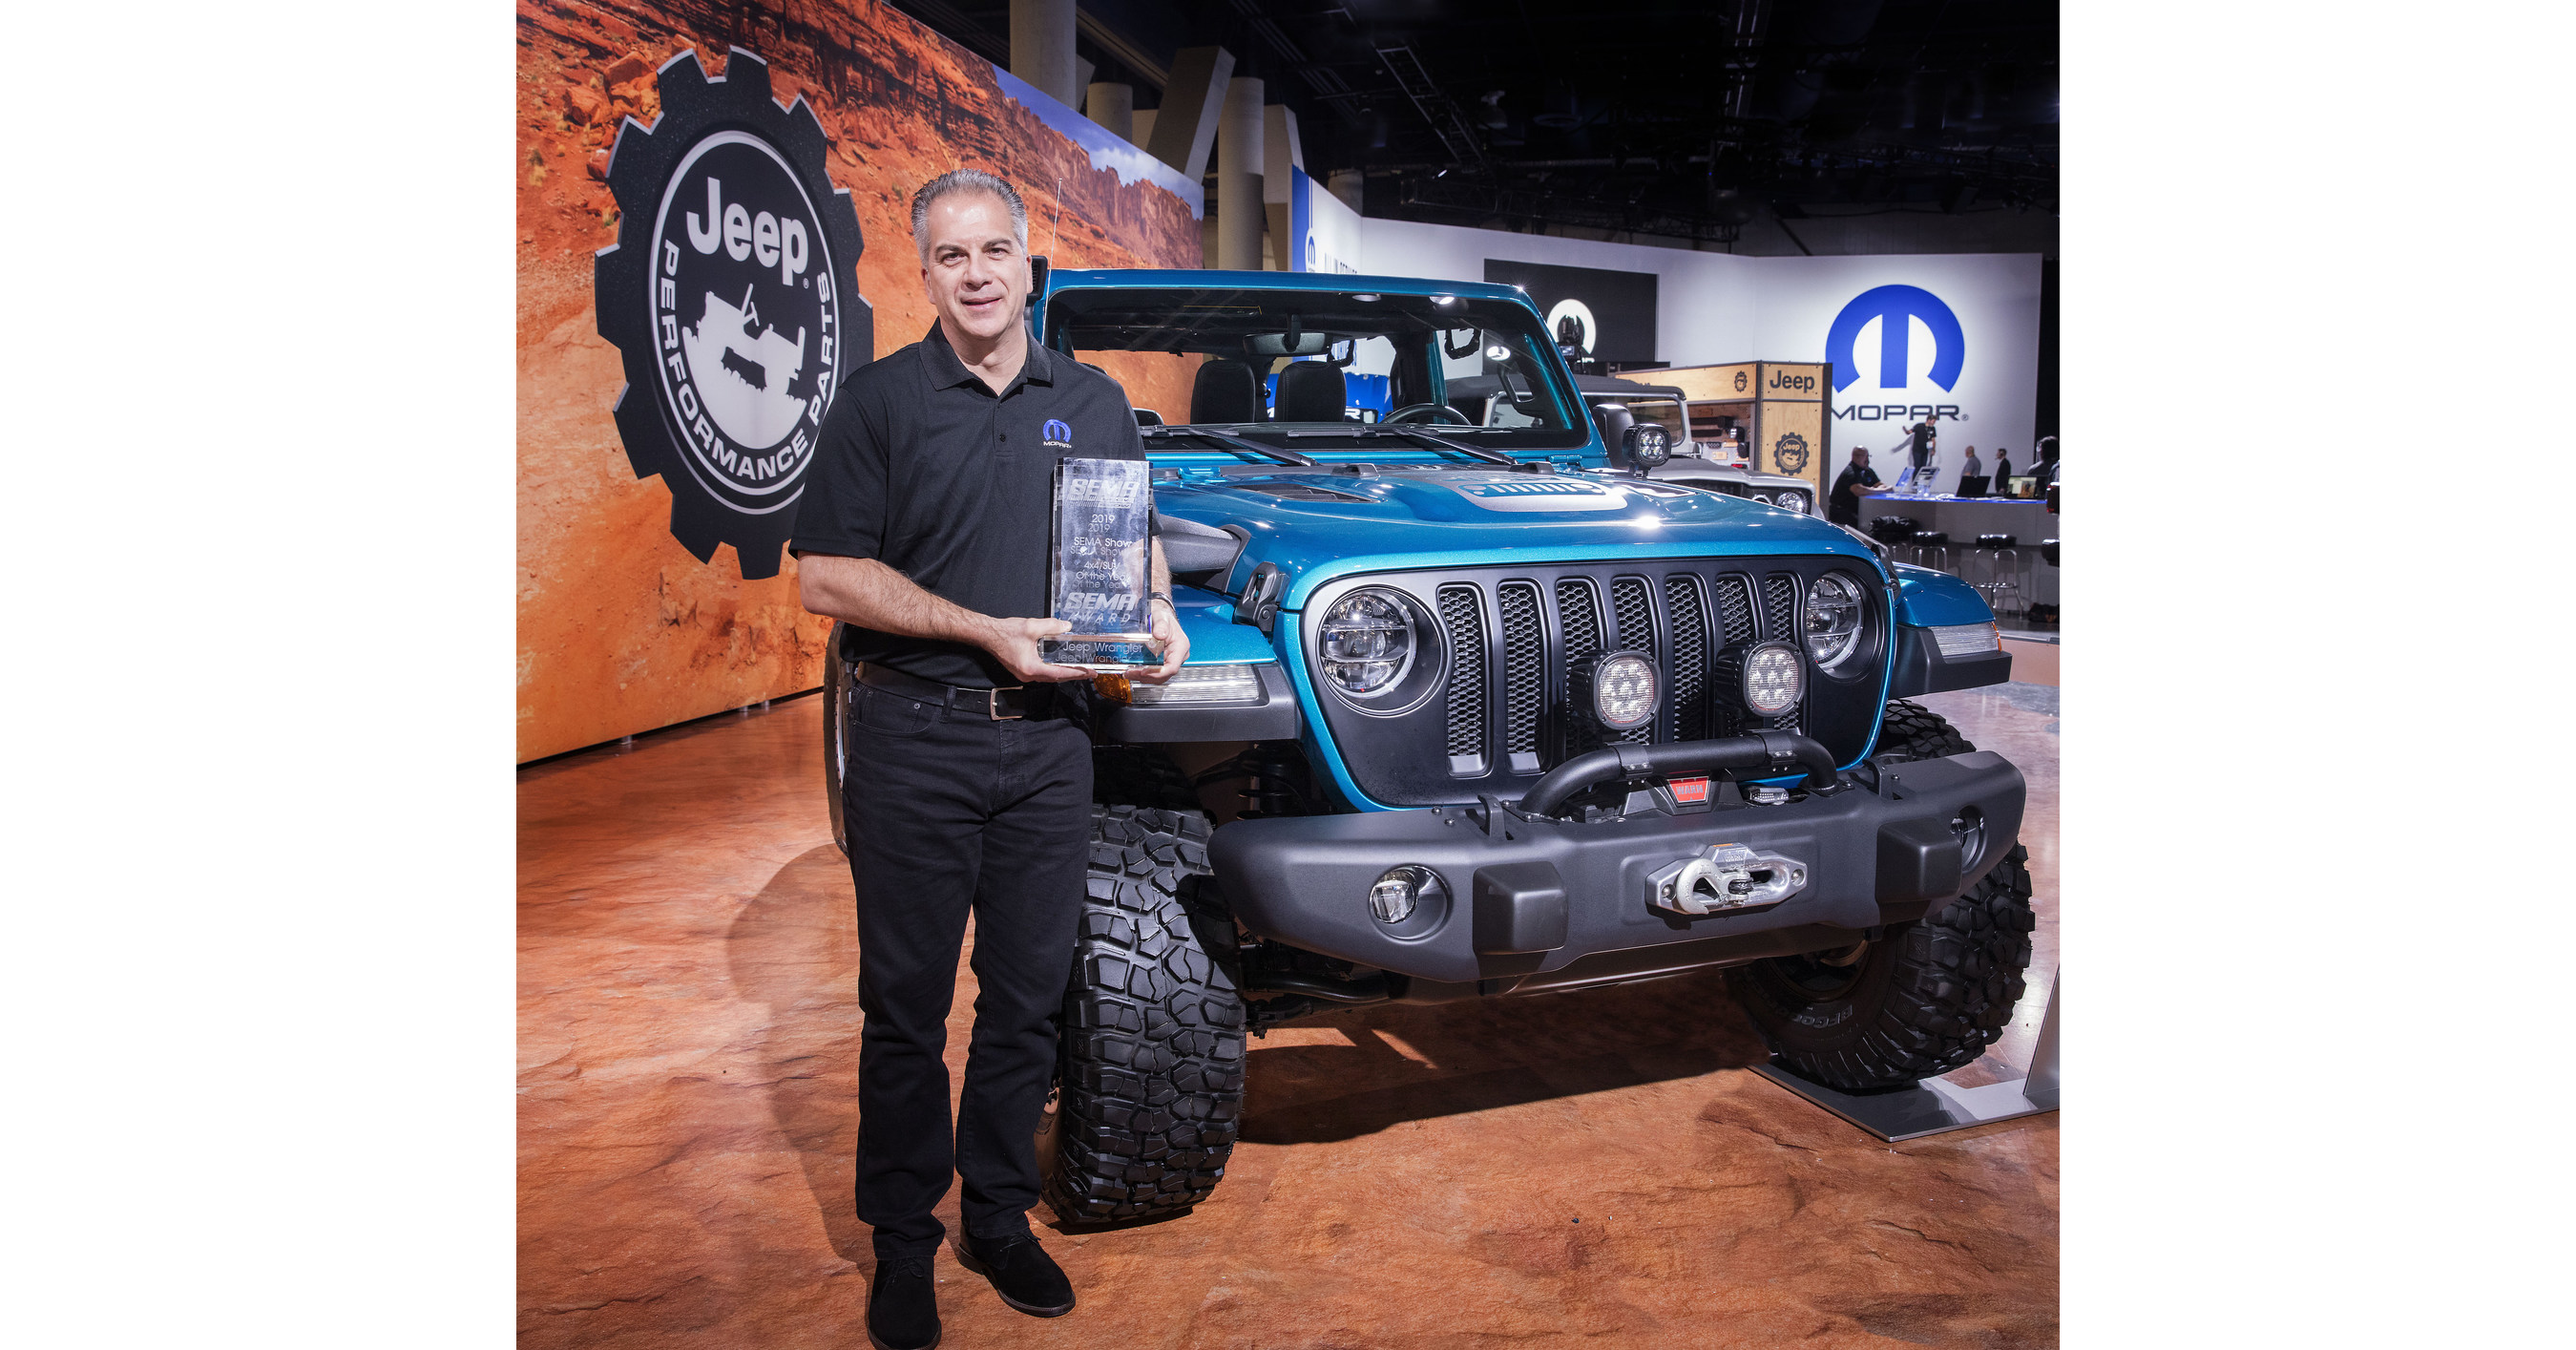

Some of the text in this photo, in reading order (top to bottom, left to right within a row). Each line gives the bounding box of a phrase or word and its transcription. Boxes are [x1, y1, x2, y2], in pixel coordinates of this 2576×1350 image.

[686, 177, 809, 286] Jeep
[660, 239, 833, 480] PERFORMANCE PARTS
[1770, 369, 1815, 393] Jeep
[1091, 514, 1116, 524] 2019
[1074, 537, 1102, 546] SEMA
[1063, 592, 1138, 612] SEMA
[1062, 642, 1143, 654] Jeep Wrangler
[1675, 784, 1704, 795] WARN
